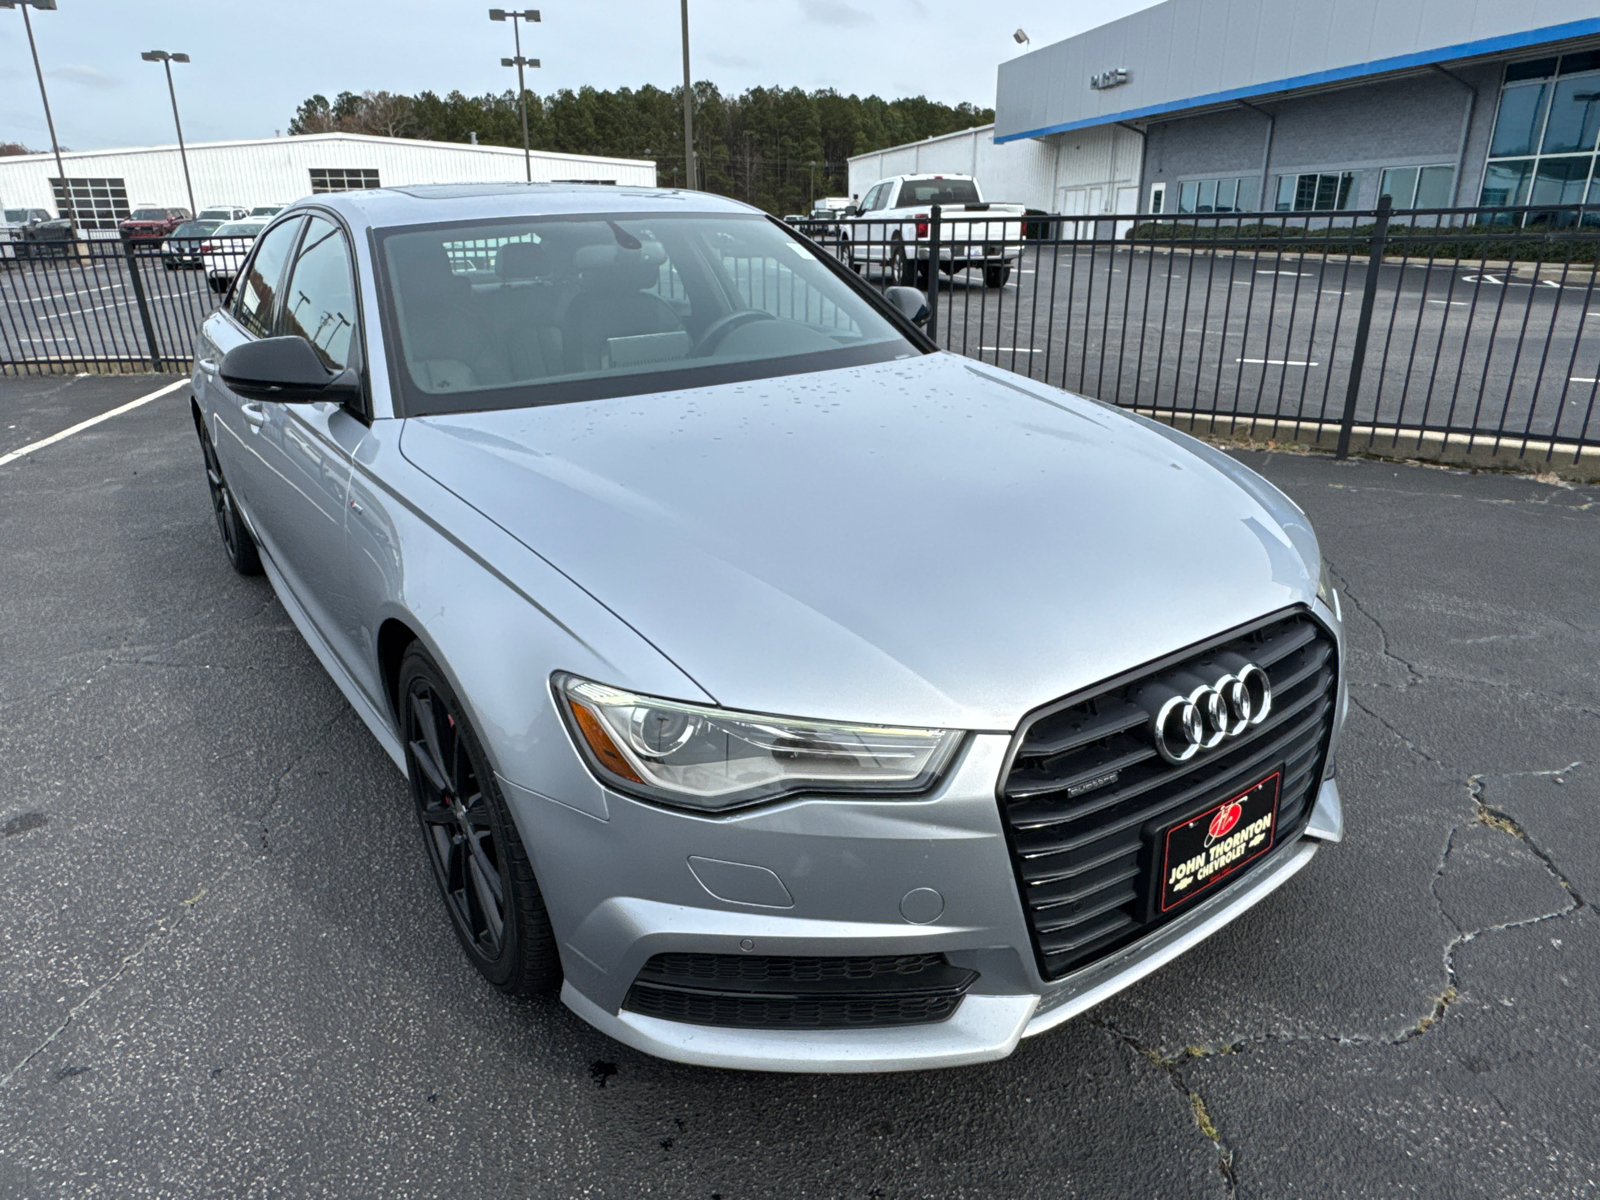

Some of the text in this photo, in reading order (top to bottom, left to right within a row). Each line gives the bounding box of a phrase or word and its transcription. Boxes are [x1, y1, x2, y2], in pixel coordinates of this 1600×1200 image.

[1169, 852, 1206, 884] JOHN
[1209, 813, 1272, 862] THORNTON
[1197, 843, 1246, 880] CHEVROLET
